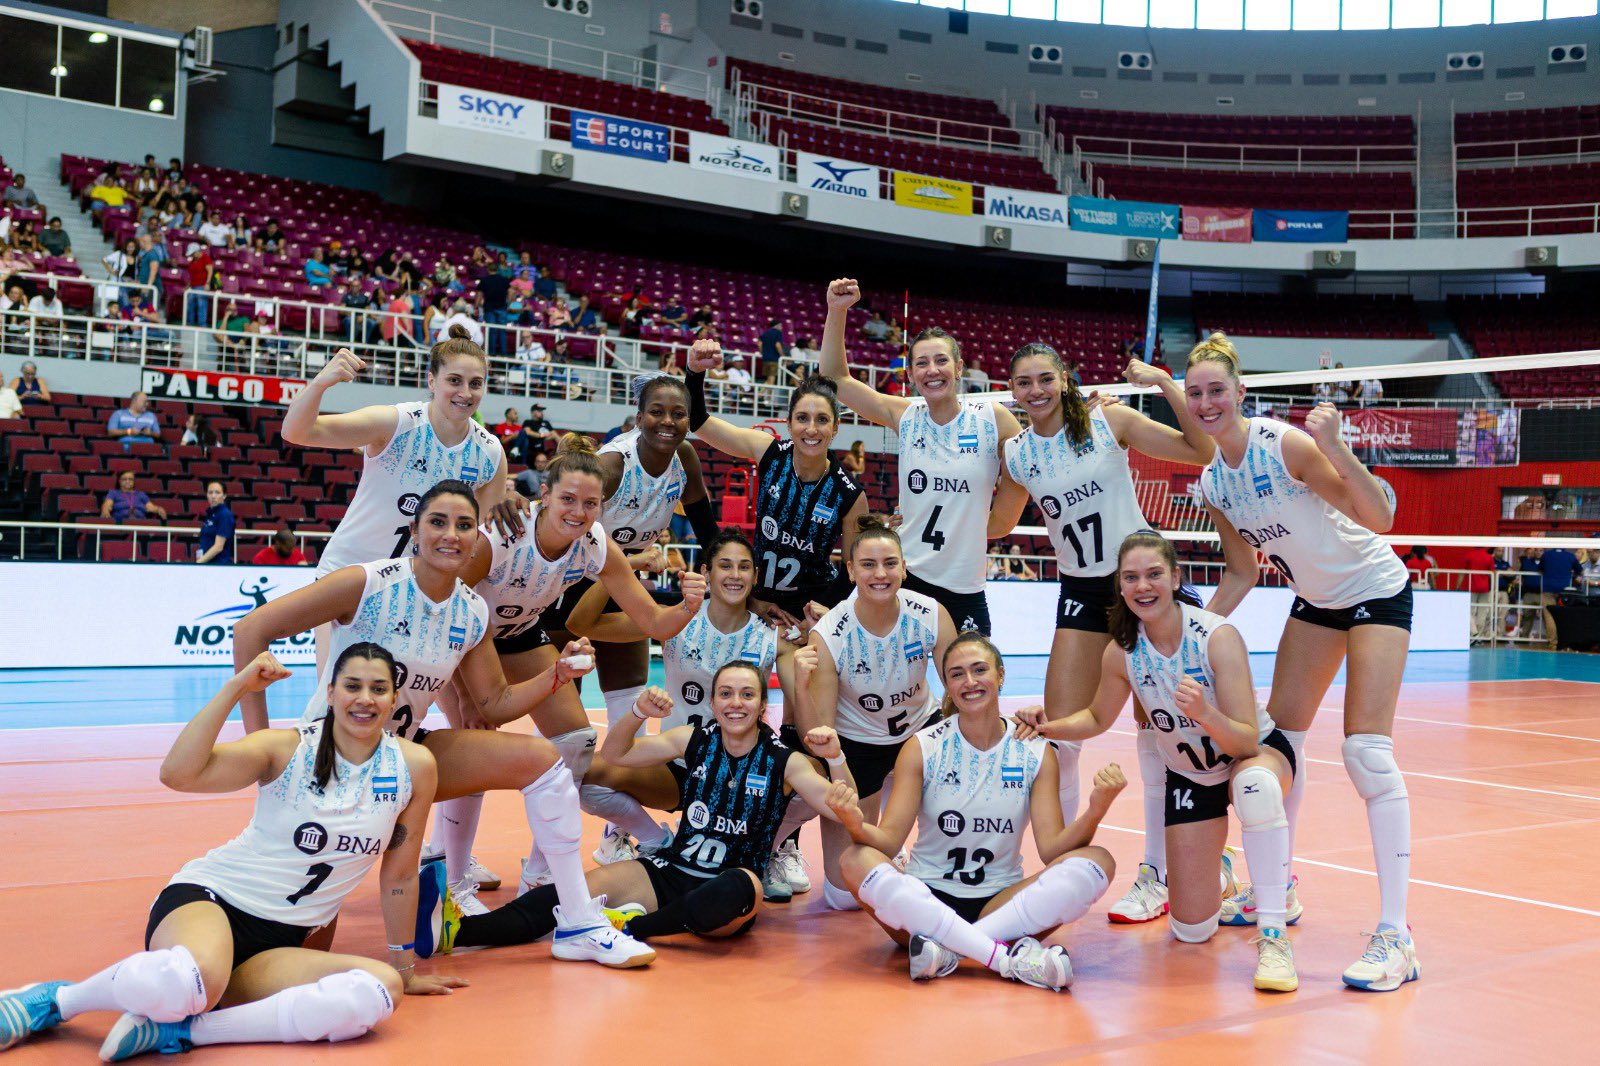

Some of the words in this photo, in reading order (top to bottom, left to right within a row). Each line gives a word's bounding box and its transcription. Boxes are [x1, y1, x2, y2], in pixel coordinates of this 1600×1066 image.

[458, 94, 525, 119] SKYY
[607, 123, 665, 141] SPORT
[607, 136, 664, 153] COURT
[700, 154, 772, 175] NORCECA
[1287, 222, 1323, 230] POPULAR
[142, 370, 265, 403] PALCO
[1361, 421, 1412, 434] VISIT
[1361, 433, 1412, 445] PONCE
[959, 446, 978, 454] ARG
[1076, 445, 1096, 459] ARG
[836, 466, 857, 492] YPF
[932, 477, 971, 493] BNA
[1063, 480, 1104, 508] BNA
[1257, 488, 1273, 499] ARG
[810, 515, 829, 526] ARG
[921, 504, 946, 552] 4
[780, 530, 815, 554] BNA
[1061, 511, 1105, 569] 17
[1258, 523, 1291, 544] BNA
[376, 562, 402, 579] YPF
[762, 550, 801, 592] 12
[904, 598, 931, 615] YPF
[1063, 598, 1085, 617] 17
[831, 612, 851, 638] YPF
[1188, 617, 1209, 639] YPF
[907, 654, 925, 664] ARG
[409, 673, 446, 693] BNA
[889, 683, 921, 708] BNA
[886, 709, 910, 737] 5
[927, 721, 953, 740] YPF
[1176, 735, 1234, 771] 14
[744, 787, 765, 797] ARG
[1003, 781, 1024, 789] ARG
[374, 794, 398, 802] ARG
[1172, 788, 1195, 810] 14
[713, 815, 749, 835] BNA
[972, 818, 1015, 834] BNA
[334, 835, 382, 855] BNA
[679, 833, 727, 868] 20
[942, 847, 995, 886] 13
